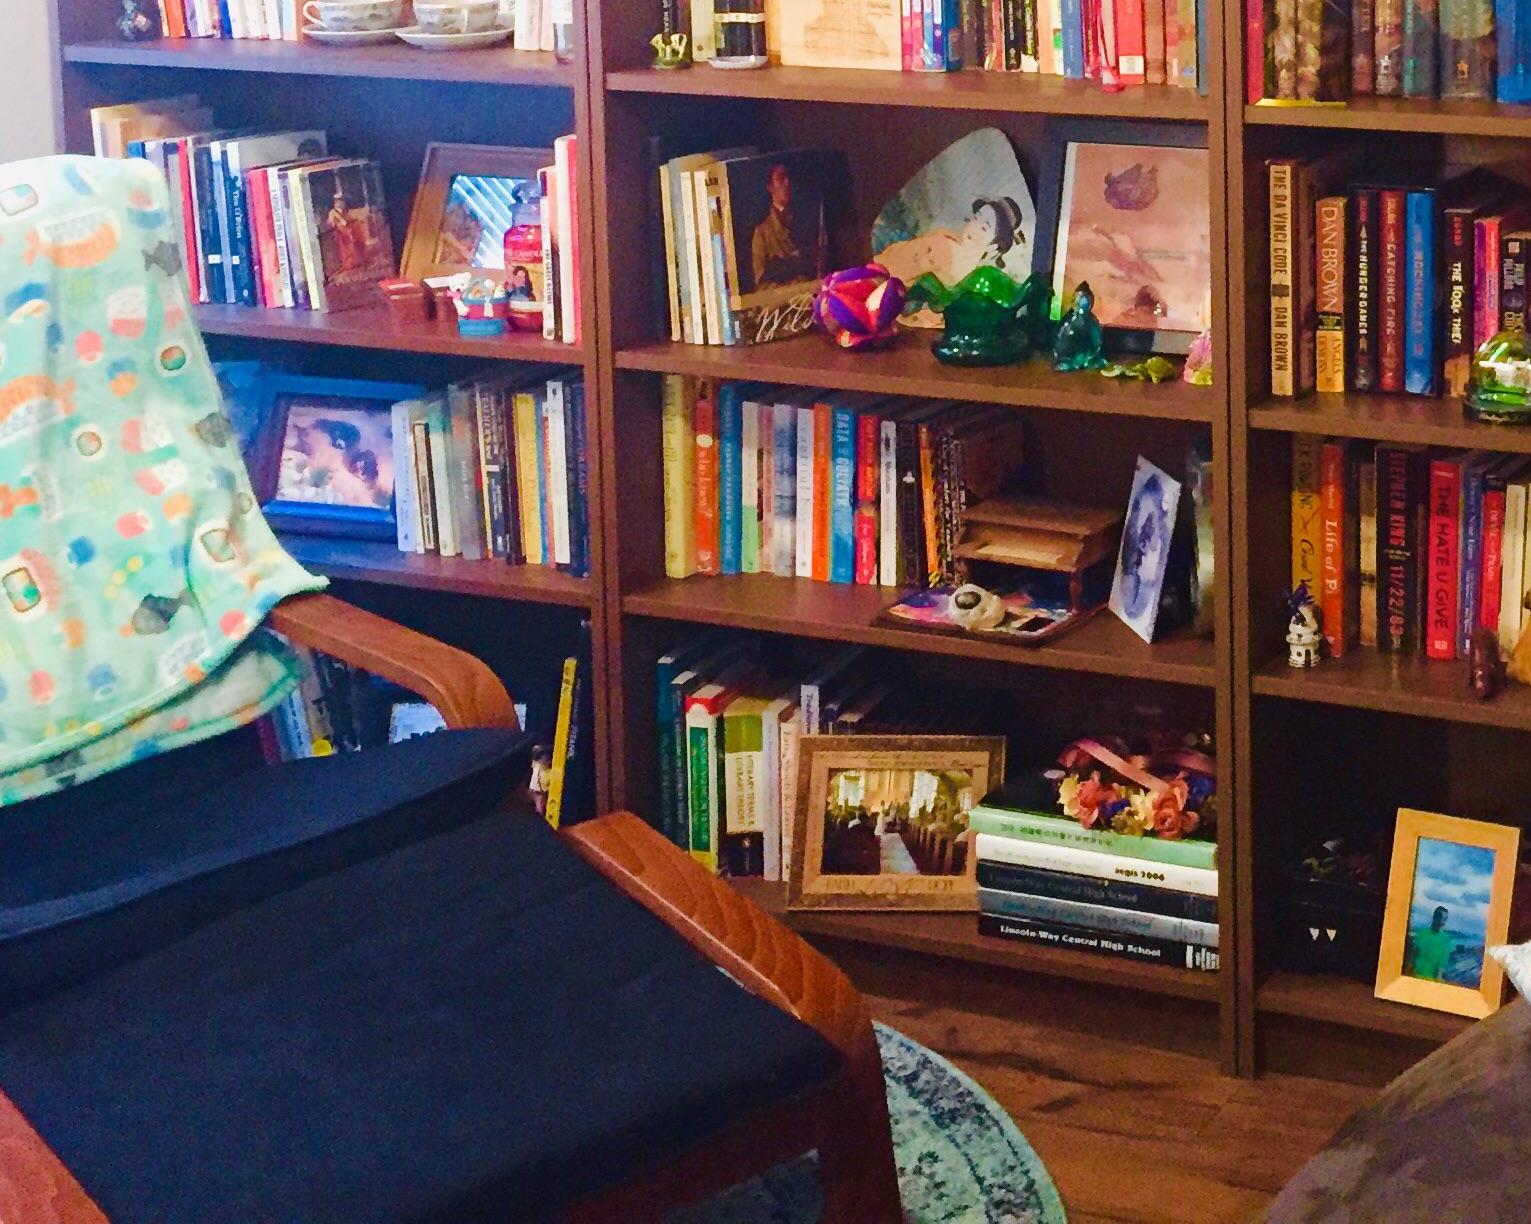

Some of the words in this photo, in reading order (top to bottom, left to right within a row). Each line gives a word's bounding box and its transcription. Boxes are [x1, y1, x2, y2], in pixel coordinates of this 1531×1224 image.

[1273, 169, 1287, 196] THE
[1273, 200, 1287, 214] DA
[1273, 217, 1287, 244] VINCI
[1321, 206, 1338, 245] DAN
[1273, 248, 1287, 276] CODE
[1452, 262, 1462, 282] THE
[1321, 246, 1338, 311] BROWN
[1274, 306, 1288, 330] DAN
[1274, 332, 1289, 372] BROWN
[1436, 487, 1450, 516] THE
[1325, 520, 1338, 552] Life
[1390, 514, 1405, 546] KING
[1435, 523, 1450, 566] HATE
[1324, 556, 1334, 571] of
[1325, 578, 1335, 594] Pi
[1436, 573, 1448, 584] U
[1434, 588, 1448, 629] GIVE
[1000, 926, 1060, 941] Lincoln-Way
[1061, 934, 1098, 946] Central
[1101, 939, 1124, 951] High
[1128, 945, 1161, 957] School
